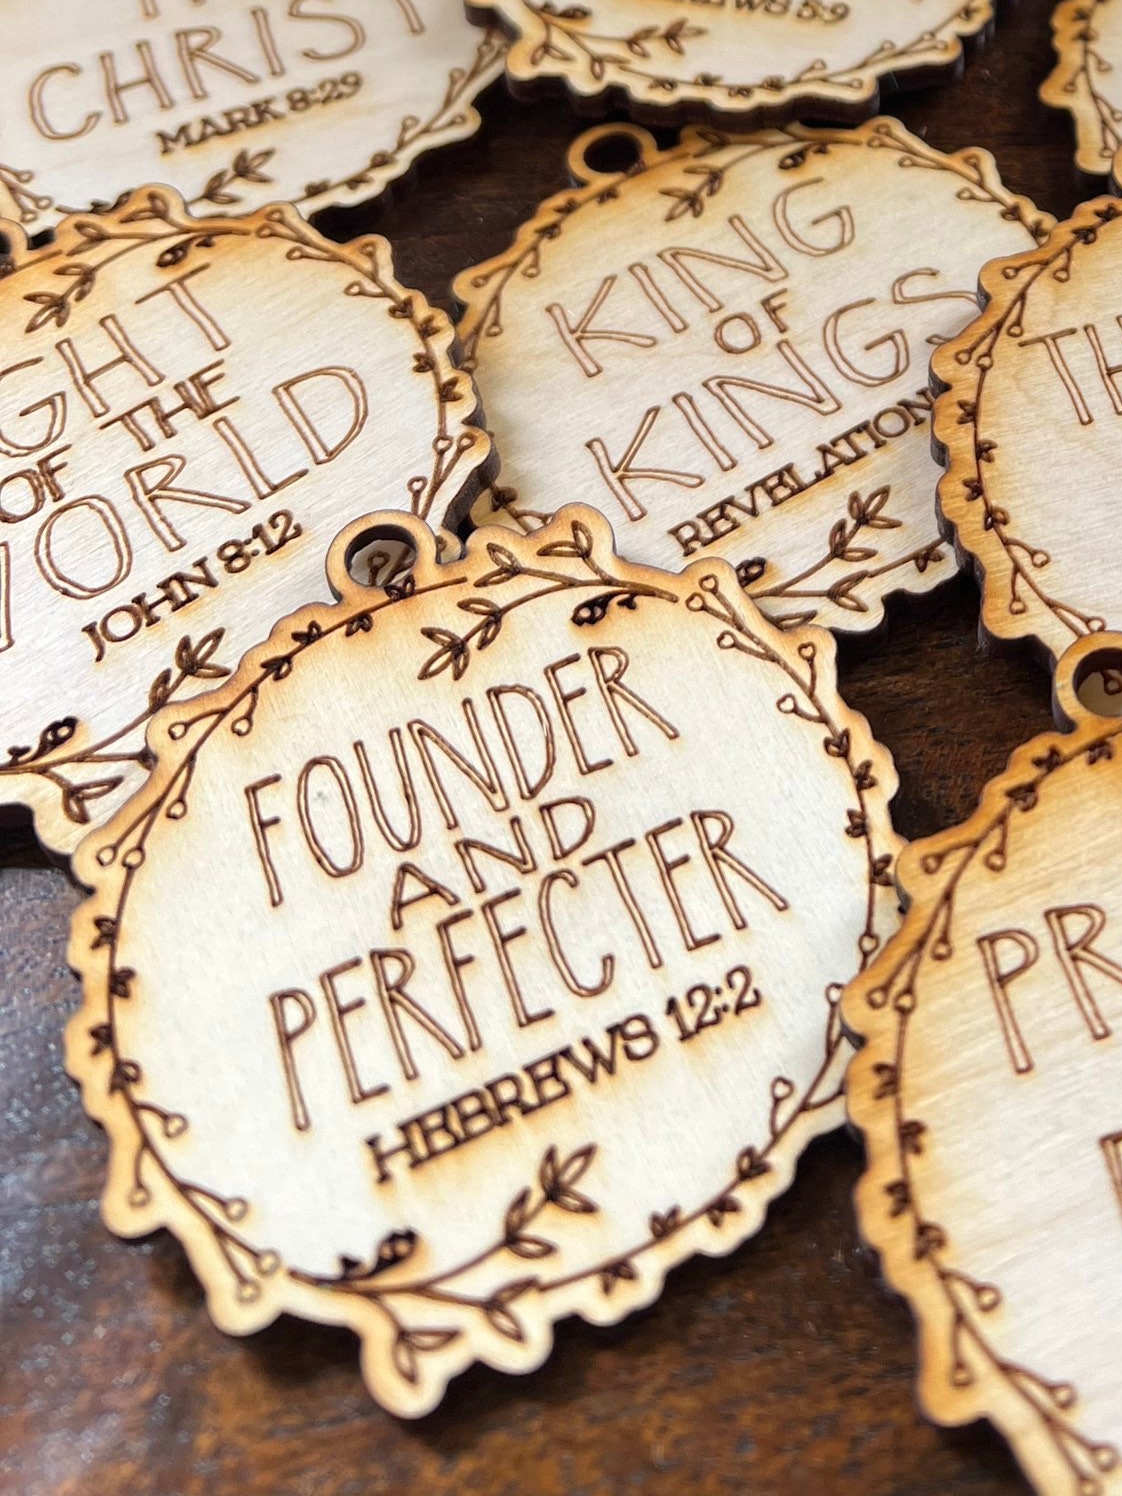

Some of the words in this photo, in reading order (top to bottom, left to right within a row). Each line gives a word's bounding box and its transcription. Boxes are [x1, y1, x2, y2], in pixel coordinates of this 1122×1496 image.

[156, 102, 285, 155] MARK
[288, 71, 364, 112] 8:29
[545, 176, 855, 378] KING
[715, 288, 788, 354] OF
[0, 444, 72, 523] OF
[99, 359, 241, 451] THE
[0, 366, 368, 651] ORLD
[668, 386, 934, 557] REVELATION
[81, 557, 219, 662] JOHN
[223, 509, 302, 575] 8:12
[243, 647, 680, 909] FOUNDER
[391, 794, 597, 931] AND
[267, 810, 789, 1132] PERFECTER
[366, 1013, 660, 1185] HEBREWS
[665, 964, 762, 1043] 12:2
